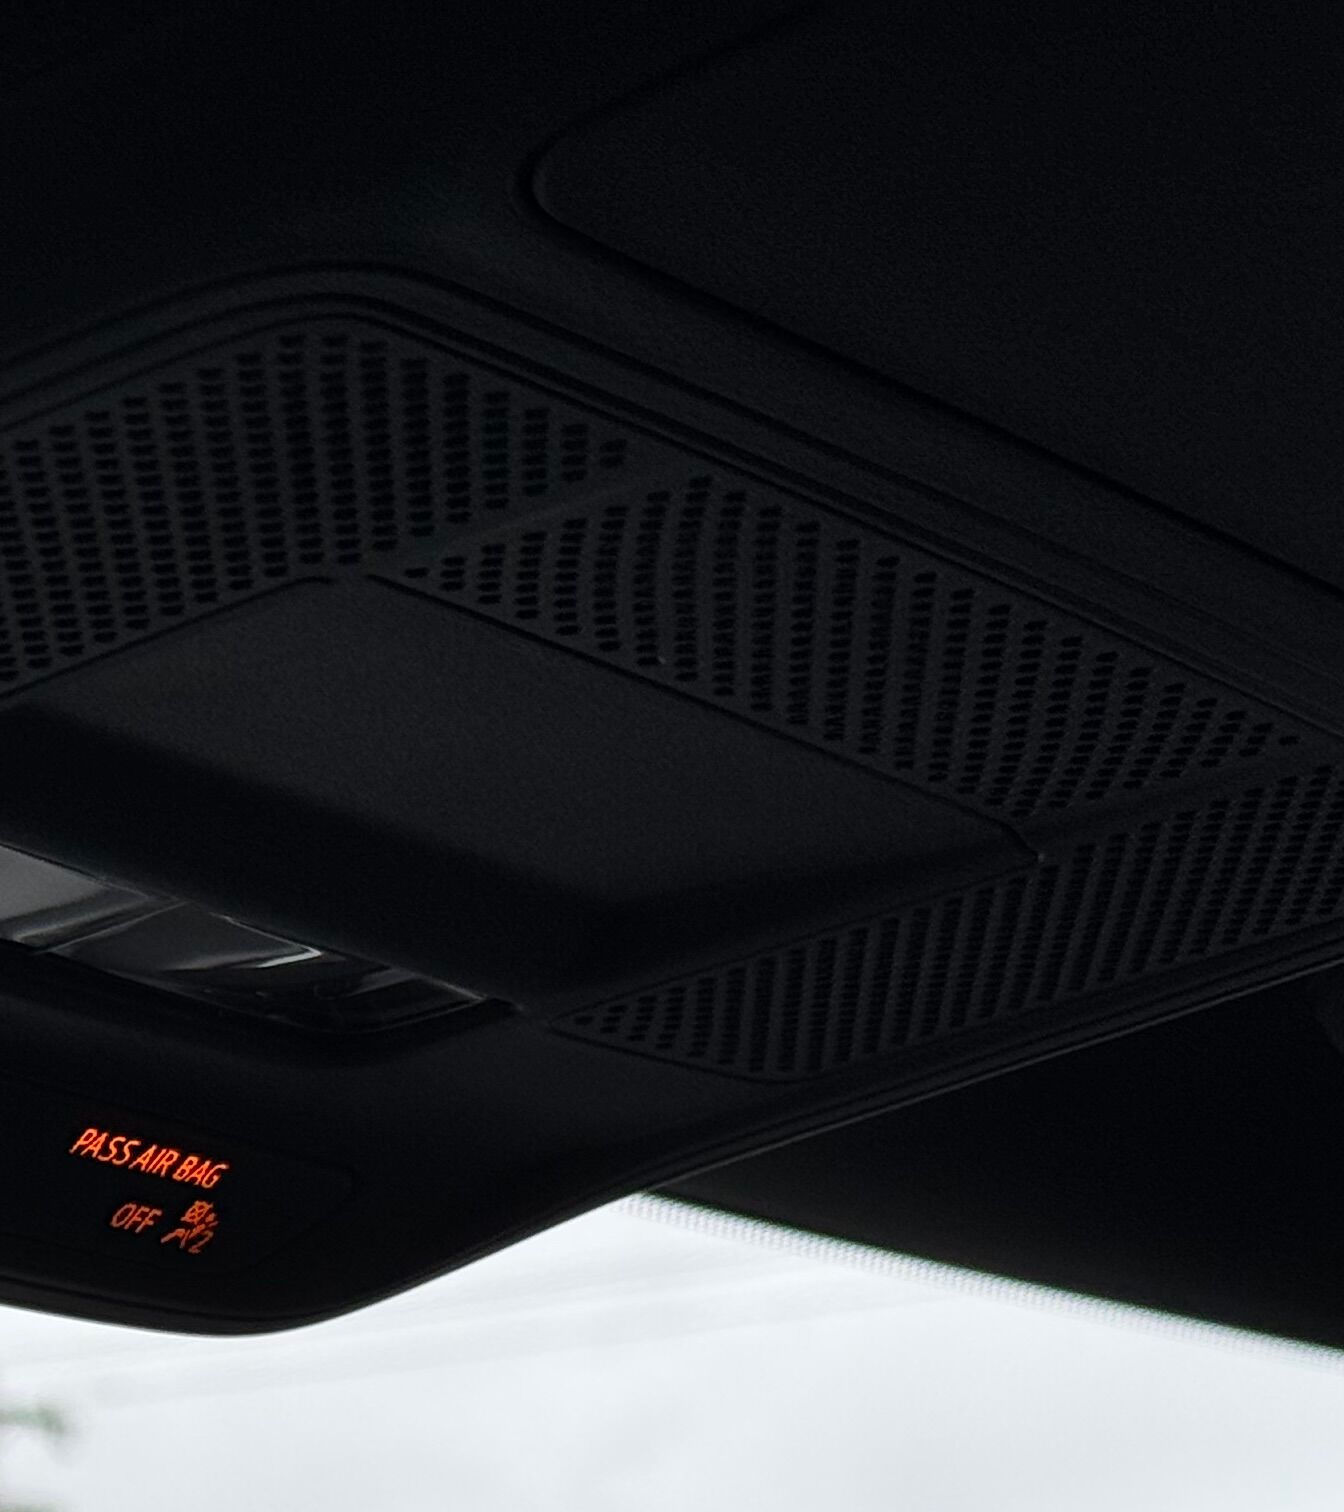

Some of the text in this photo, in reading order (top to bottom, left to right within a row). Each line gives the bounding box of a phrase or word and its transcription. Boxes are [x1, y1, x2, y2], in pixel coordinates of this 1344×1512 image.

[69, 1127, 230, 1189] PASS AIR BAG
[110, 1201, 163, 1234] OFF
